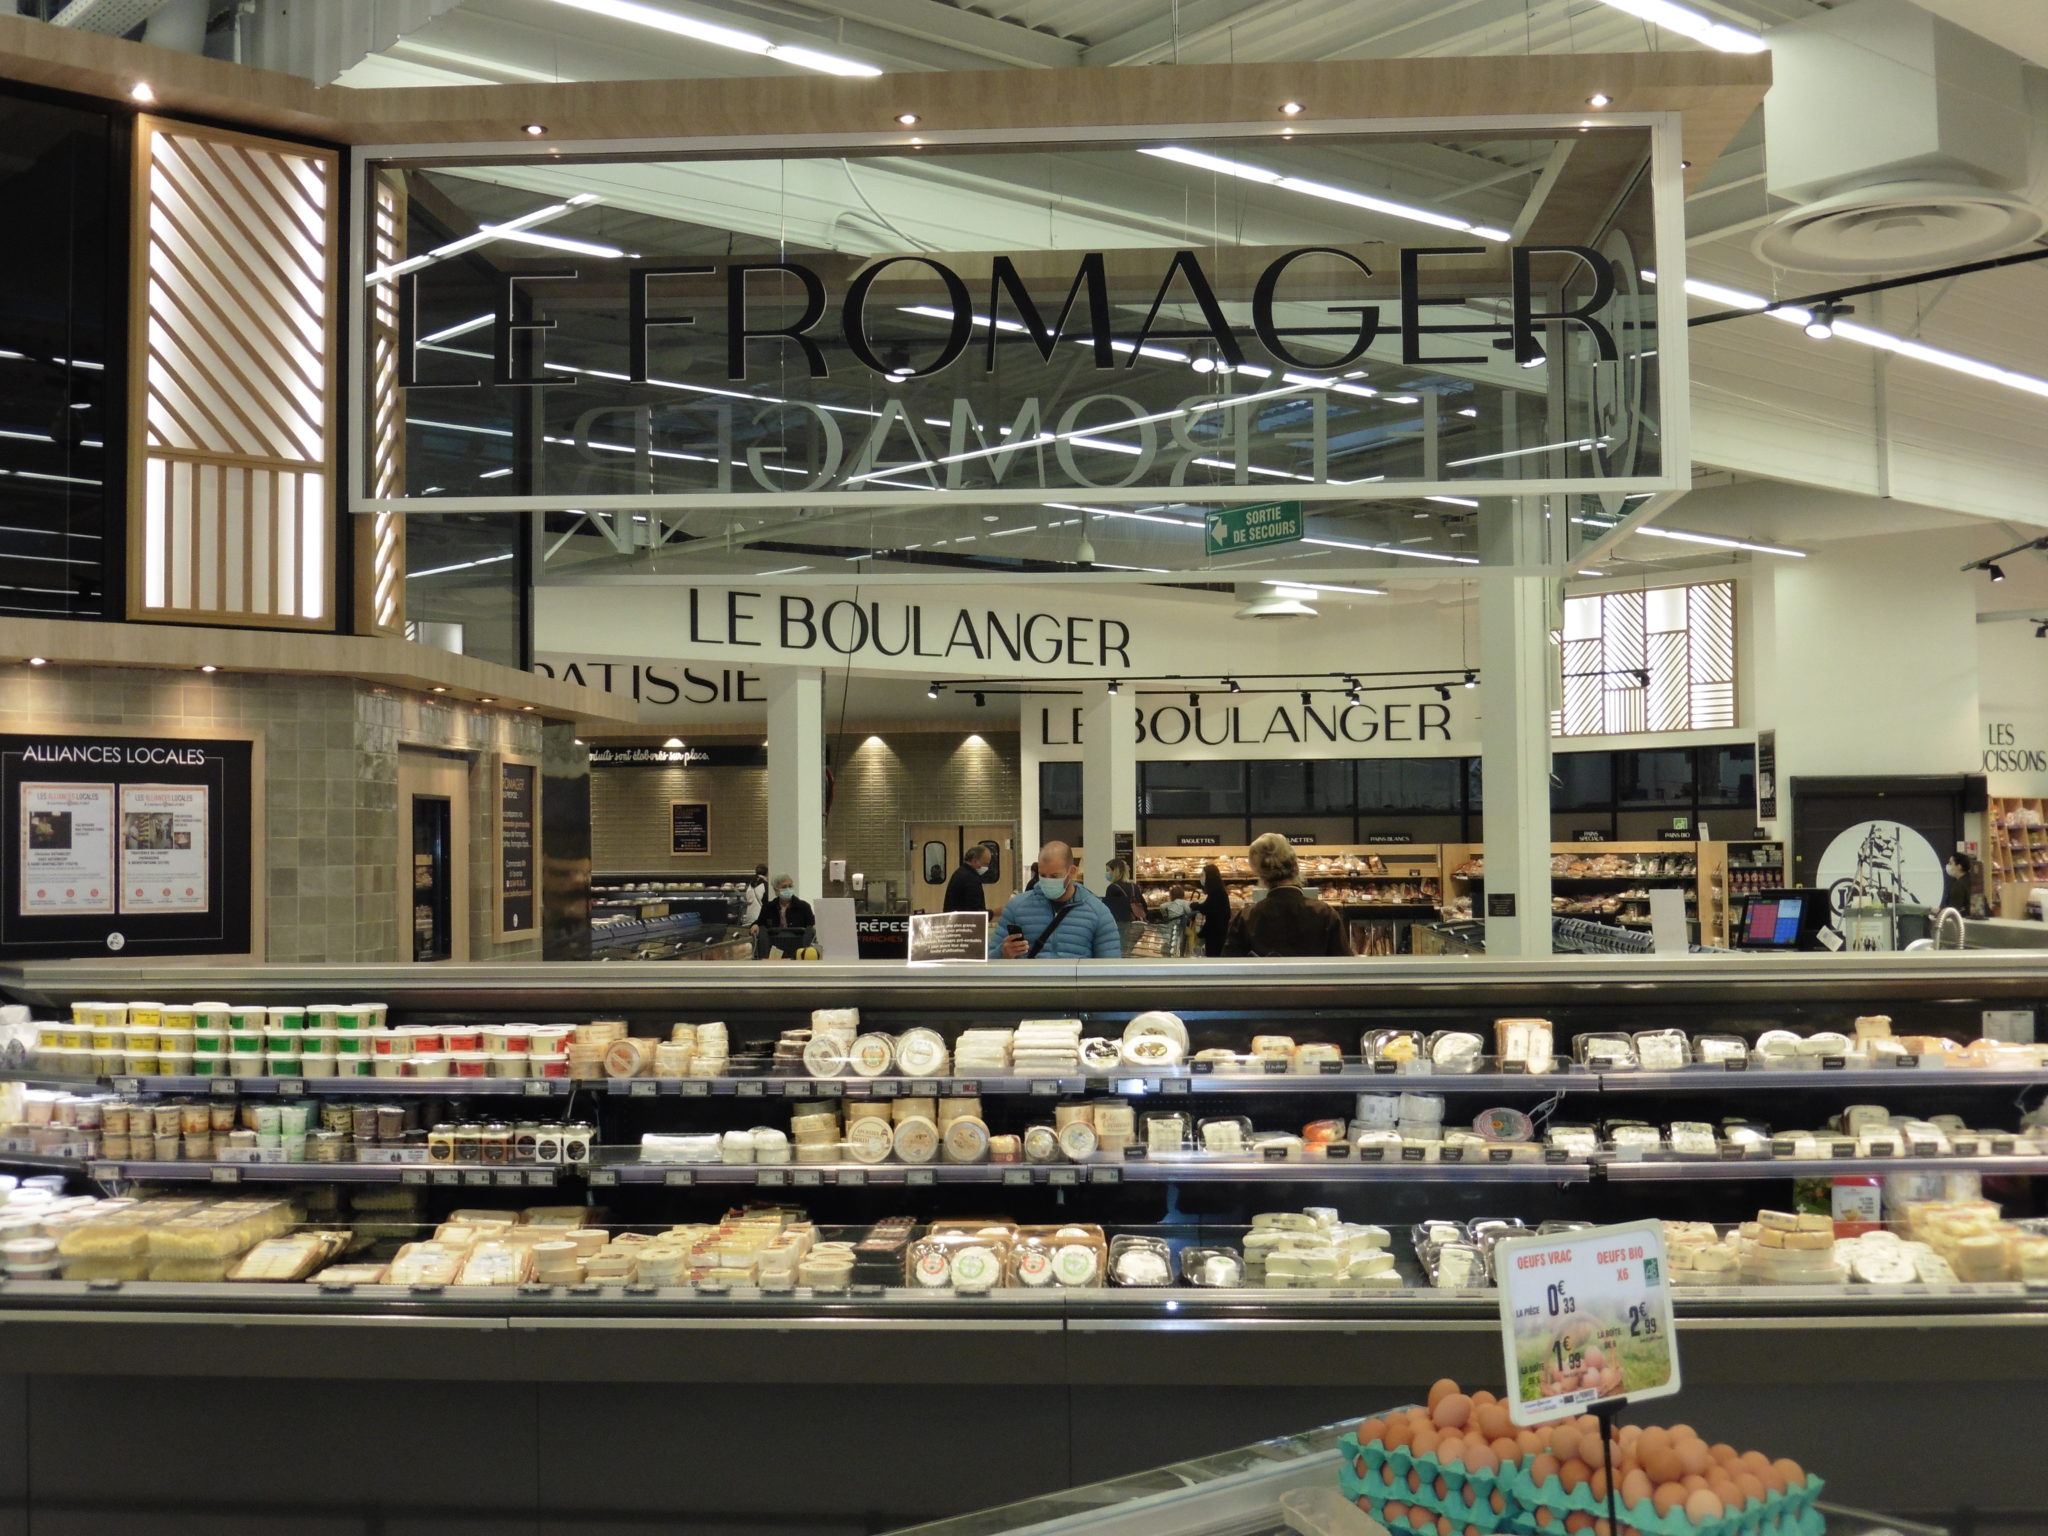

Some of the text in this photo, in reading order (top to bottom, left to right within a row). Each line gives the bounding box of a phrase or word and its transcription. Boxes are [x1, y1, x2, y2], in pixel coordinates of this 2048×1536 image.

[399, 246, 1620, 388] LE FROMAGER
[1246, 506, 1282, 526] SORTIE
[1233, 520, 1296, 544] DE SECOURS
[690, 588, 1131, 668] LE BOULANGER
[1988, 723, 2015, 746] LES
[22, 745, 205, 766] ALLIANCES LOCALES
[1517, 1249, 1572, 1270] OEUFS VRAC
[1597, 1246, 1644, 1265] OEUFS BIO
[1616, 1267, 1629, 1281] X6
